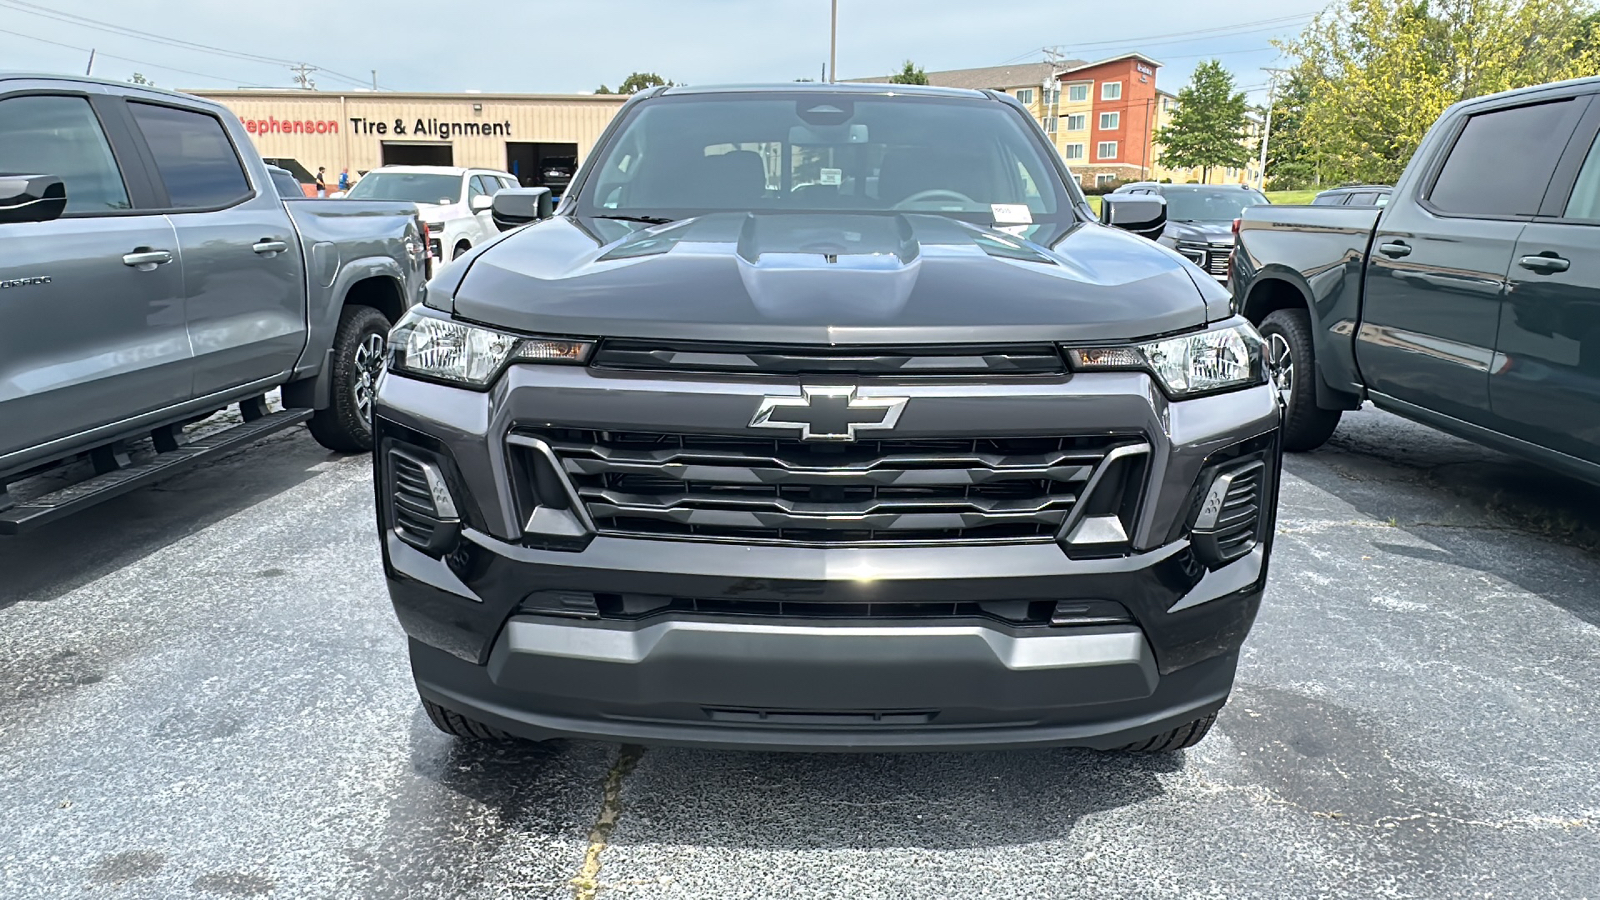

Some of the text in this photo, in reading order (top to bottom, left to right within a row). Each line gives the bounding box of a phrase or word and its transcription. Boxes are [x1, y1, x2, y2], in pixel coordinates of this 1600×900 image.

[350, 117, 512, 140] Tire & Alignment
